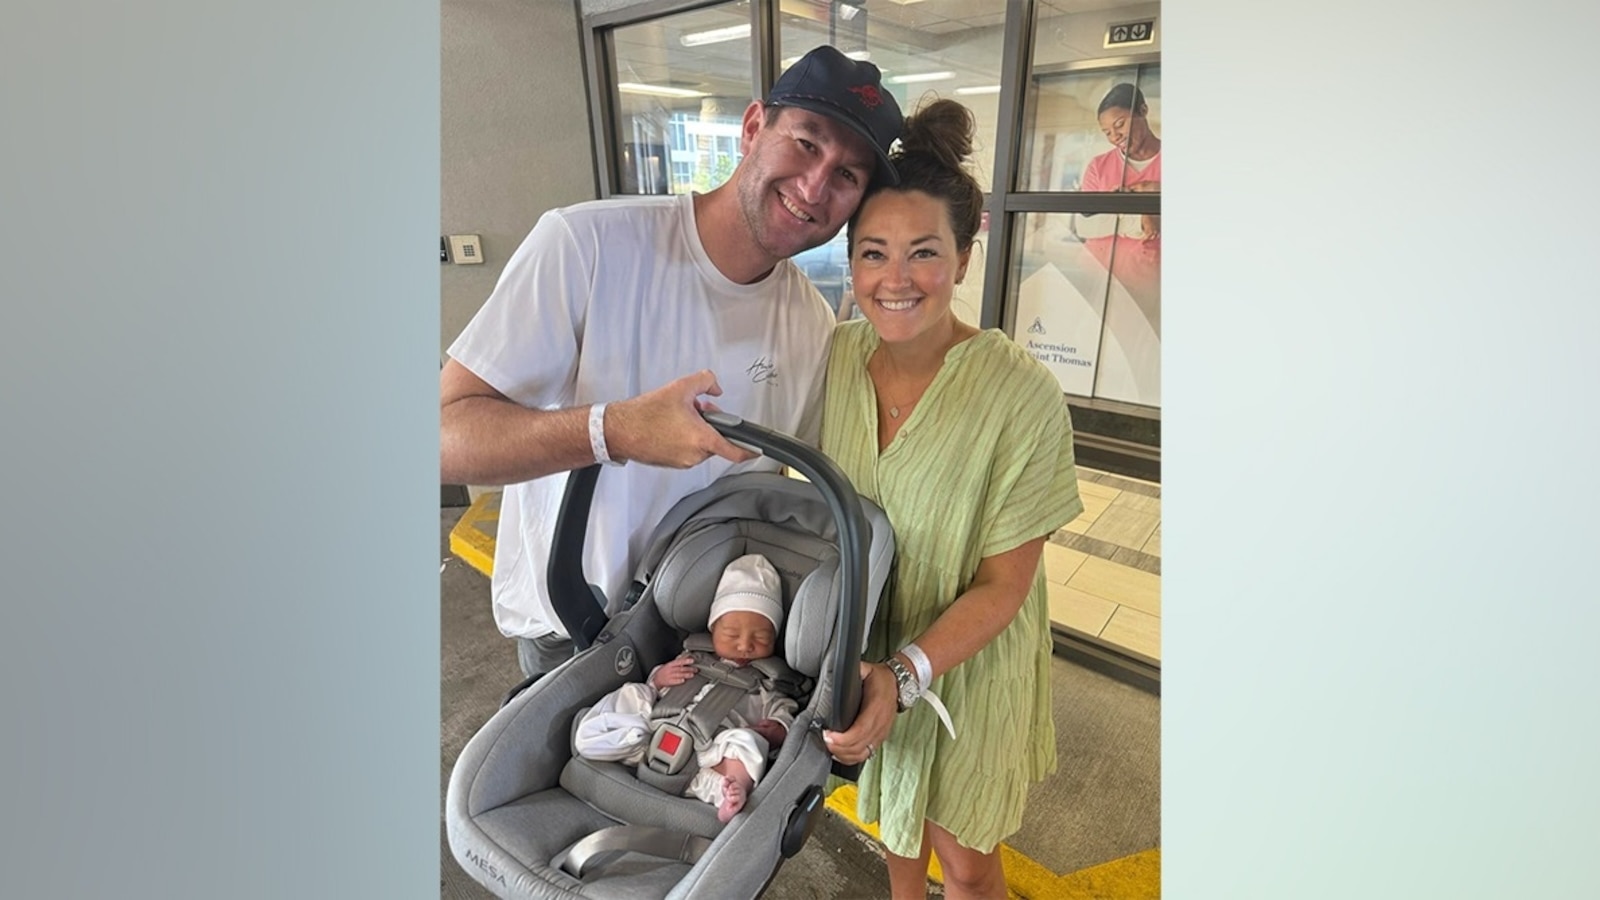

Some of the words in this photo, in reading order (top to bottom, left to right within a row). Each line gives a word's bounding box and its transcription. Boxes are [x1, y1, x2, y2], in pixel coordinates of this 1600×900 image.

[1026, 340, 1076, 354] Ascension
[1052, 353, 1092, 367] Thomas
[465, 849, 507, 888] MESA
